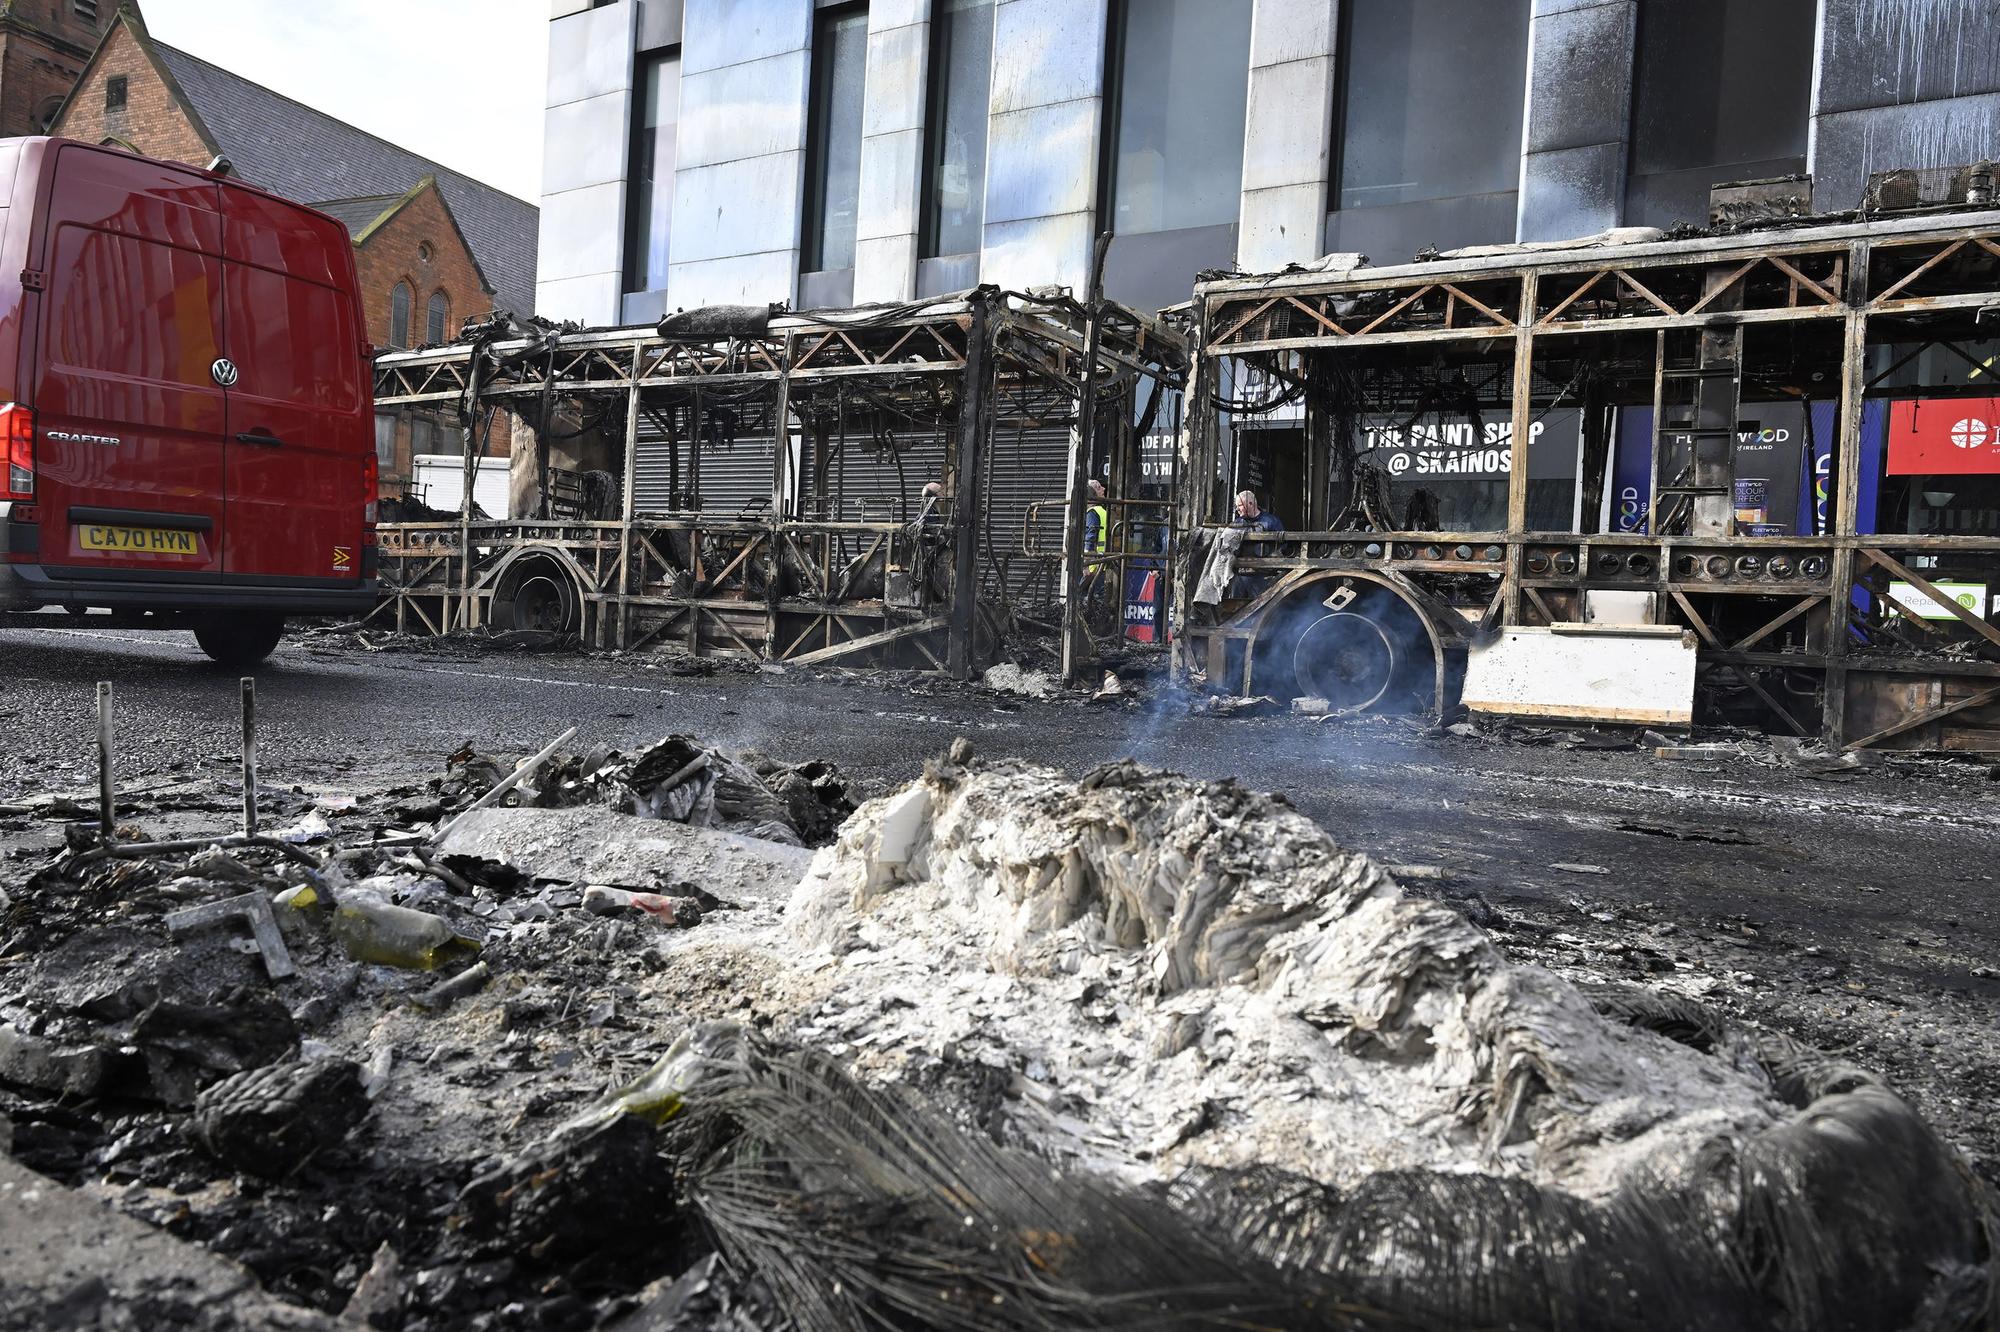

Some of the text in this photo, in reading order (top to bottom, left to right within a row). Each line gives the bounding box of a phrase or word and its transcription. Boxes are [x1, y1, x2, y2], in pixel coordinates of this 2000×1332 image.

[46, 431, 121, 446] CRAFTER
[1364, 421, 1544, 448] THE PAINT SHP
[1387, 449, 1513, 476] @ SKAINOS
[1734, 487, 1765, 495] OLOUR
[89, 527, 191, 550] CA70 HYN
